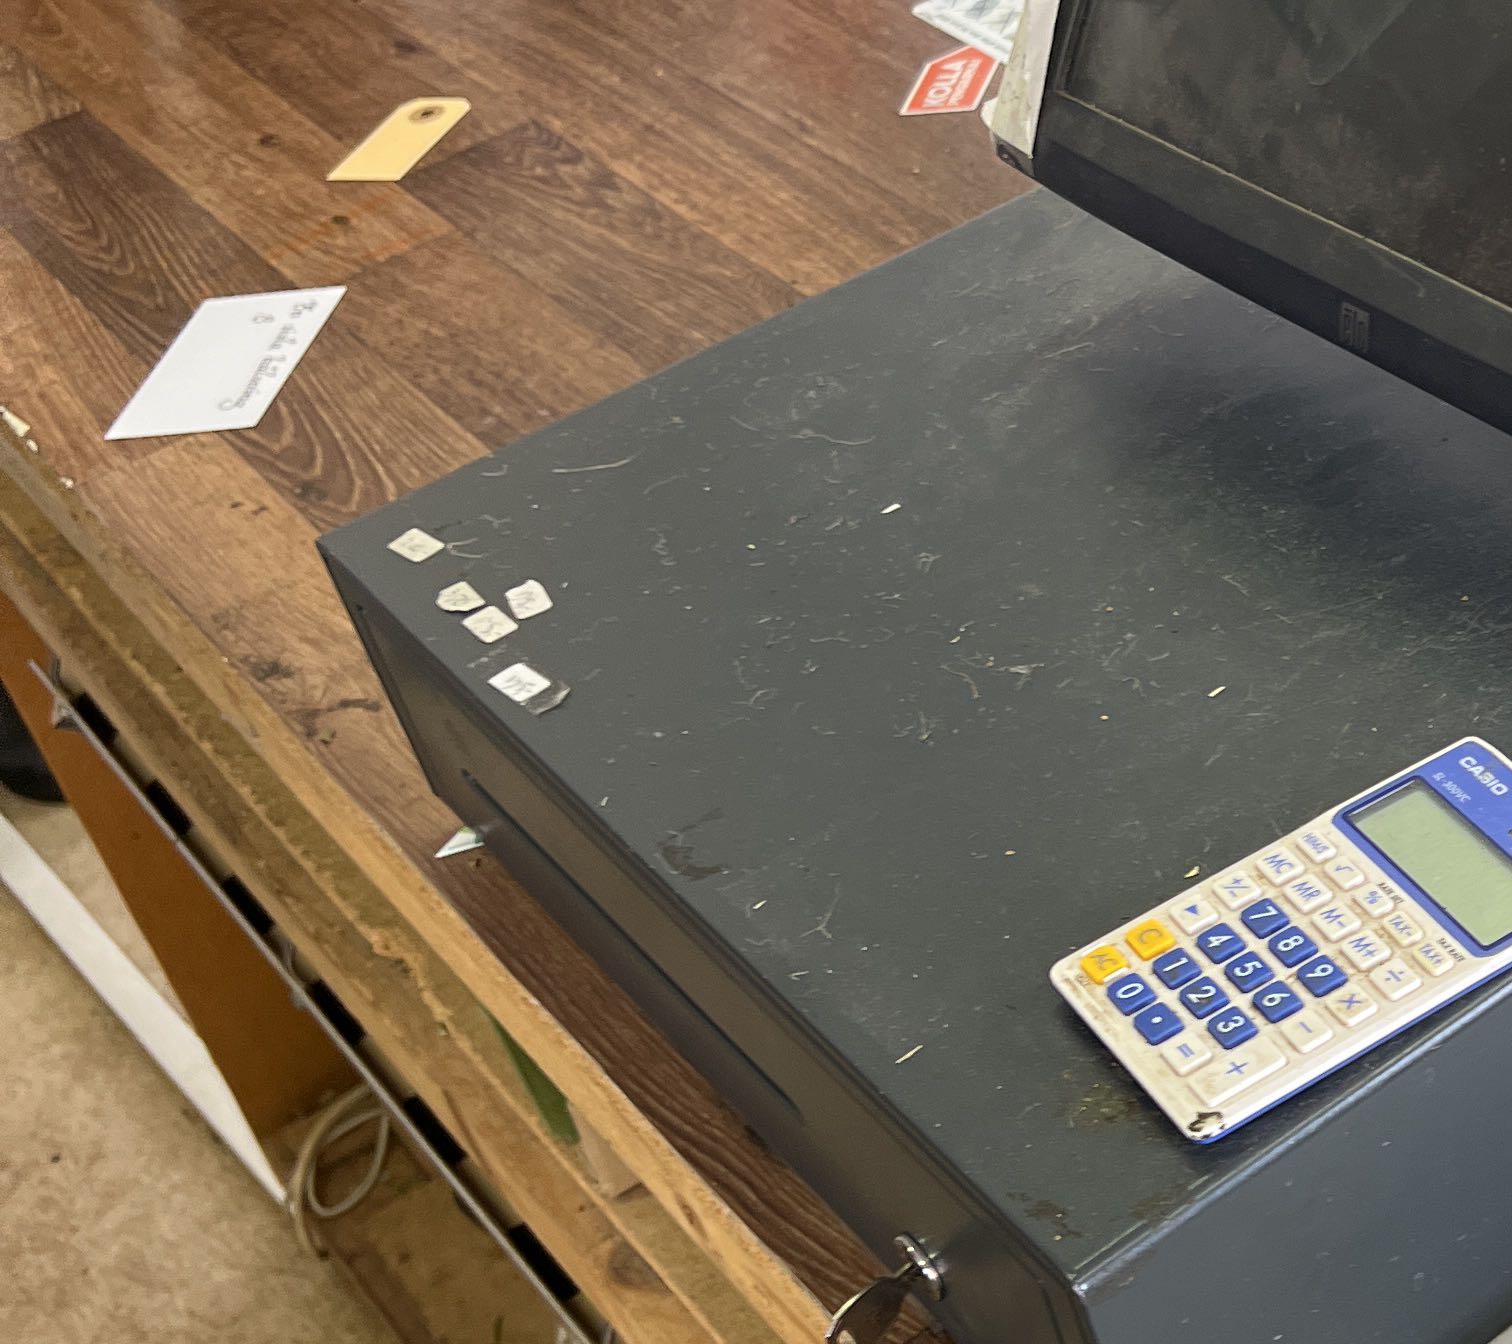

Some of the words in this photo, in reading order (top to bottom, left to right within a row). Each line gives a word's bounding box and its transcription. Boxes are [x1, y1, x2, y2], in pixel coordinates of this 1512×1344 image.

[1458, 756, 1510, 796] CASIO
[1264, 853, 1295, 874] MC
[1291, 880, 1322, 901] MR
[1249, 906, 1279, 920] 7
[1139, 928, 1163, 945] C
[1207, 934, 1235, 948] 4
[1277, 935, 1305, 952] 8
[1347, 935, 1379, 956] M+
[1163, 957, 1189, 972] 1
[1233, 960, 1263, 977] 5
[1306, 963, 1334, 978] 9
[1116, 982, 1145, 999] 0
[1186, 985, 1216, 1004] 2
[1262, 992, 1291, 1007] 6
[1216, 1015, 1246, 1033] 3
